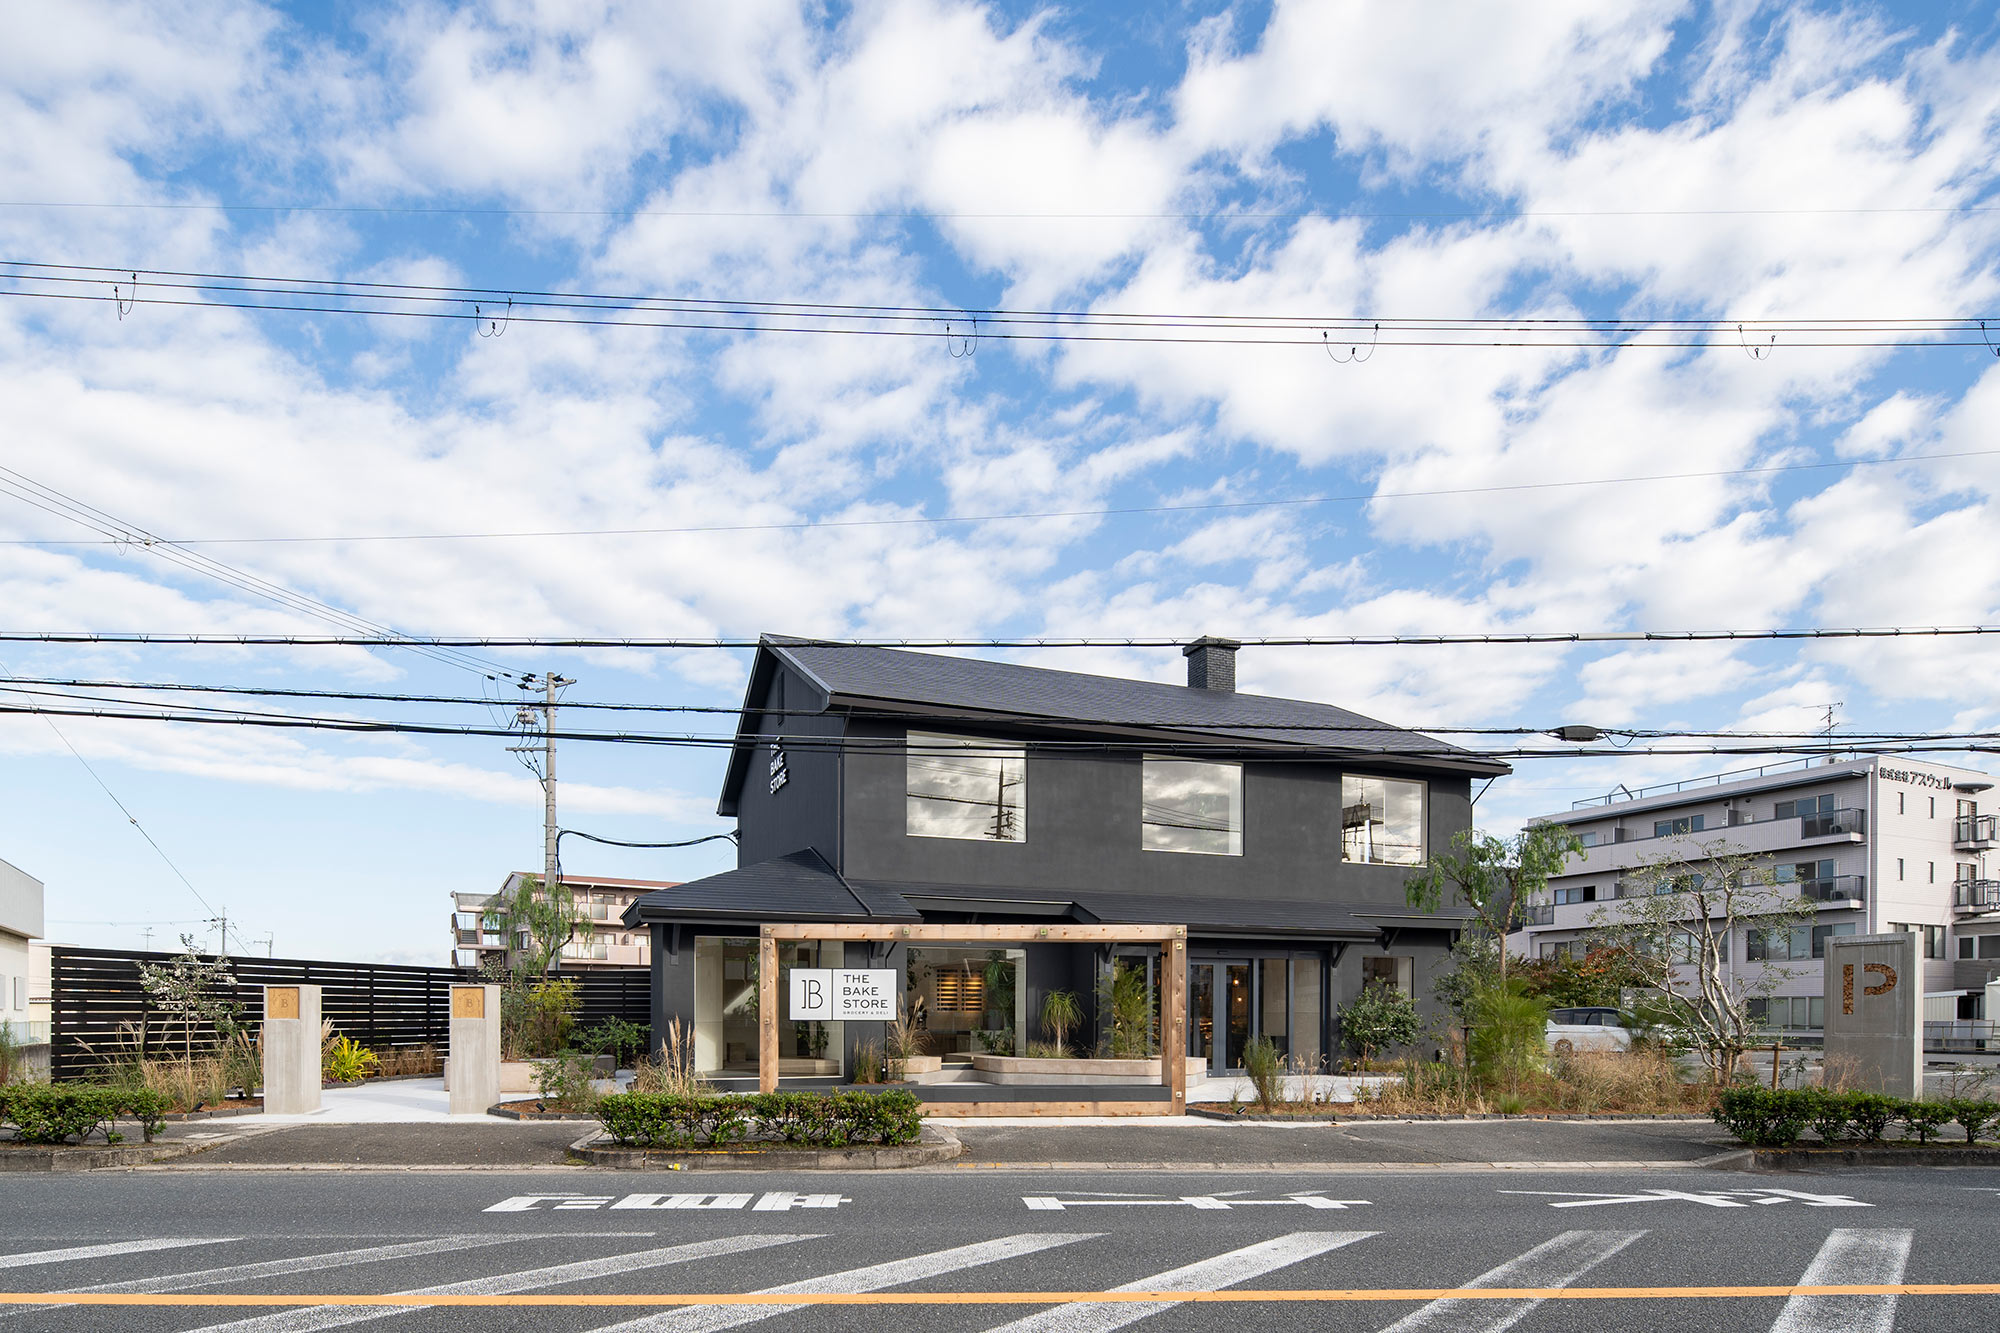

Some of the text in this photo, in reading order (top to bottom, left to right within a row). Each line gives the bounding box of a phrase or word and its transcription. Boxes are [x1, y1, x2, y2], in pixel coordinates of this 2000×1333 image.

[770, 751, 784, 777] BAKE
[770, 768, 787, 795] STORE
[843, 974, 870, 984] THE
[843, 986, 879, 996] BAKE
[1842, 963, 1898, 1015] P
[843, 998, 889, 1009] STORE
